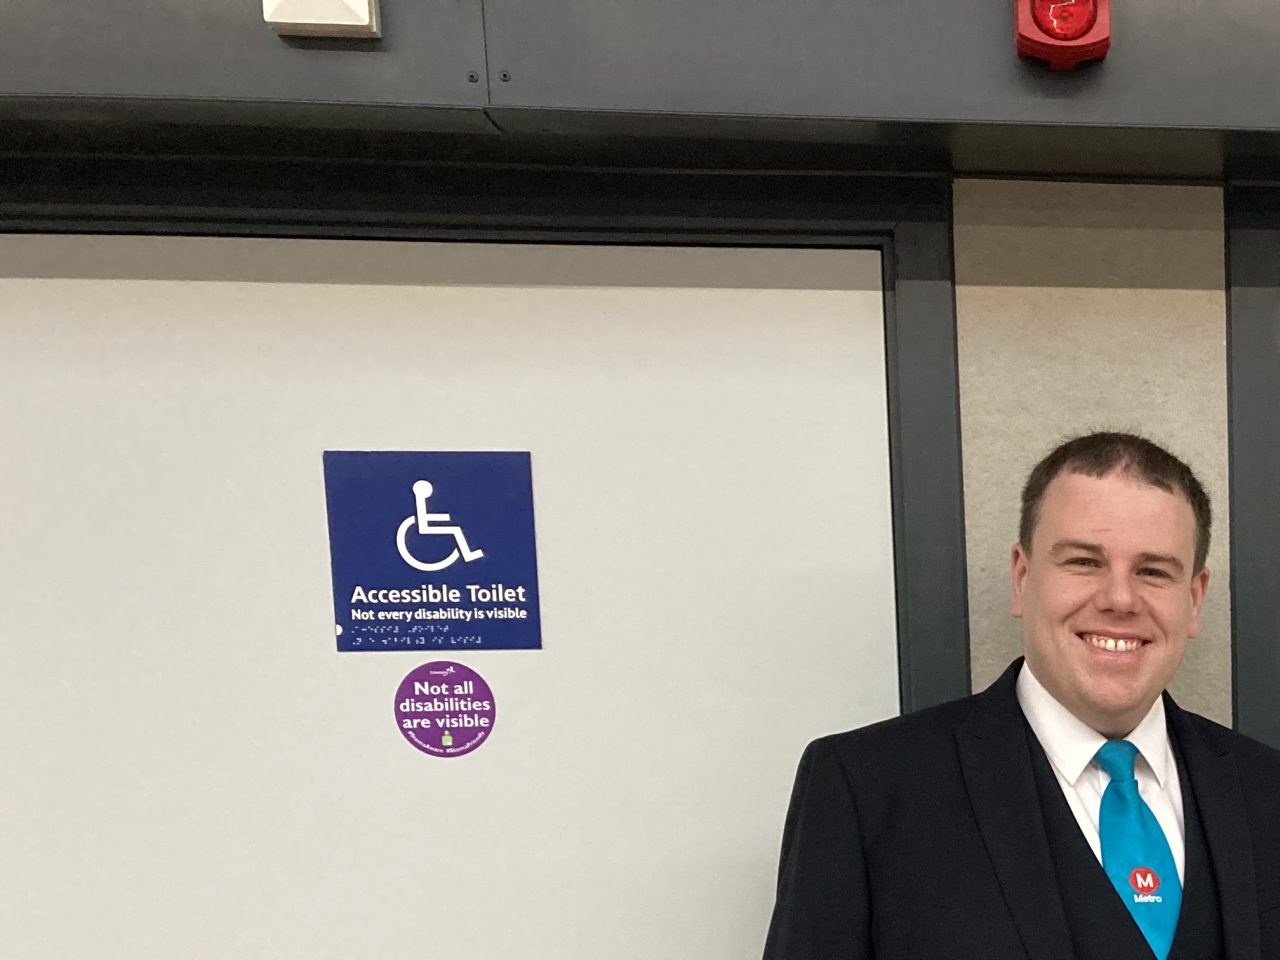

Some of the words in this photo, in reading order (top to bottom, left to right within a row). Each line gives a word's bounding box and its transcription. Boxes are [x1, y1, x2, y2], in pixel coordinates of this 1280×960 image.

[351, 584, 461, 604] Accessible
[466, 583, 526, 602] Toilet
[351, 608, 375, 620] Not
[377, 610, 412, 622] every
[414, 607, 472, 622] disability
[474, 607, 484, 619] is
[486, 607, 527, 619] visible
[414, 681, 449, 695] Not
[454, 680, 474, 694] all
[400, 697, 491, 712] disabilities
[402, 718, 431, 728] are
[435, 713, 490, 728] visible
[1135, 872, 1154, 888] M
[1133, 893, 1163, 904] Metro
